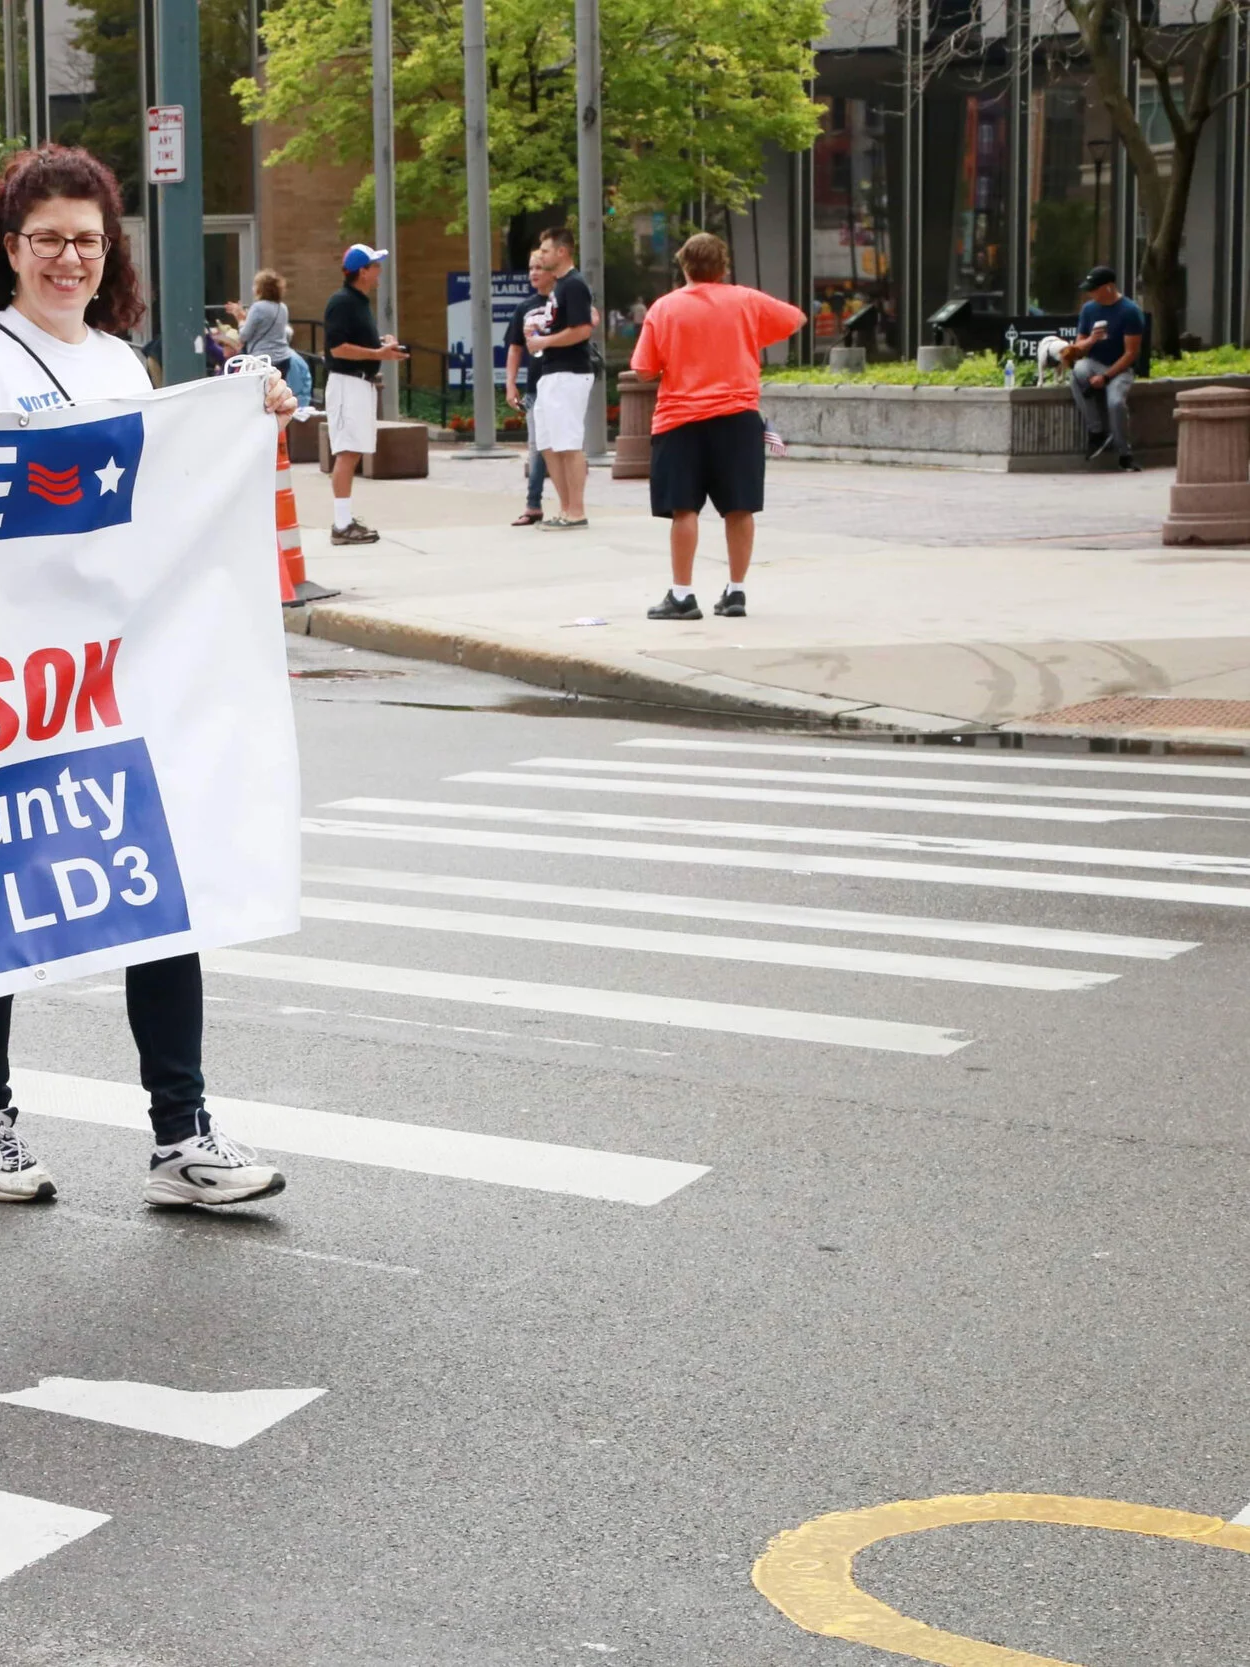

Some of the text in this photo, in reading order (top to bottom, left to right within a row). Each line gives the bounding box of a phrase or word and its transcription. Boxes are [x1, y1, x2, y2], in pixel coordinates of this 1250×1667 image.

[158, 136, 172, 145] ANY
[157, 151, 174, 160] TIME
[1059, 327, 1077, 337] THE
[17, 391, 60, 412] VOTE
[3, 845, 159, 934] LD3
